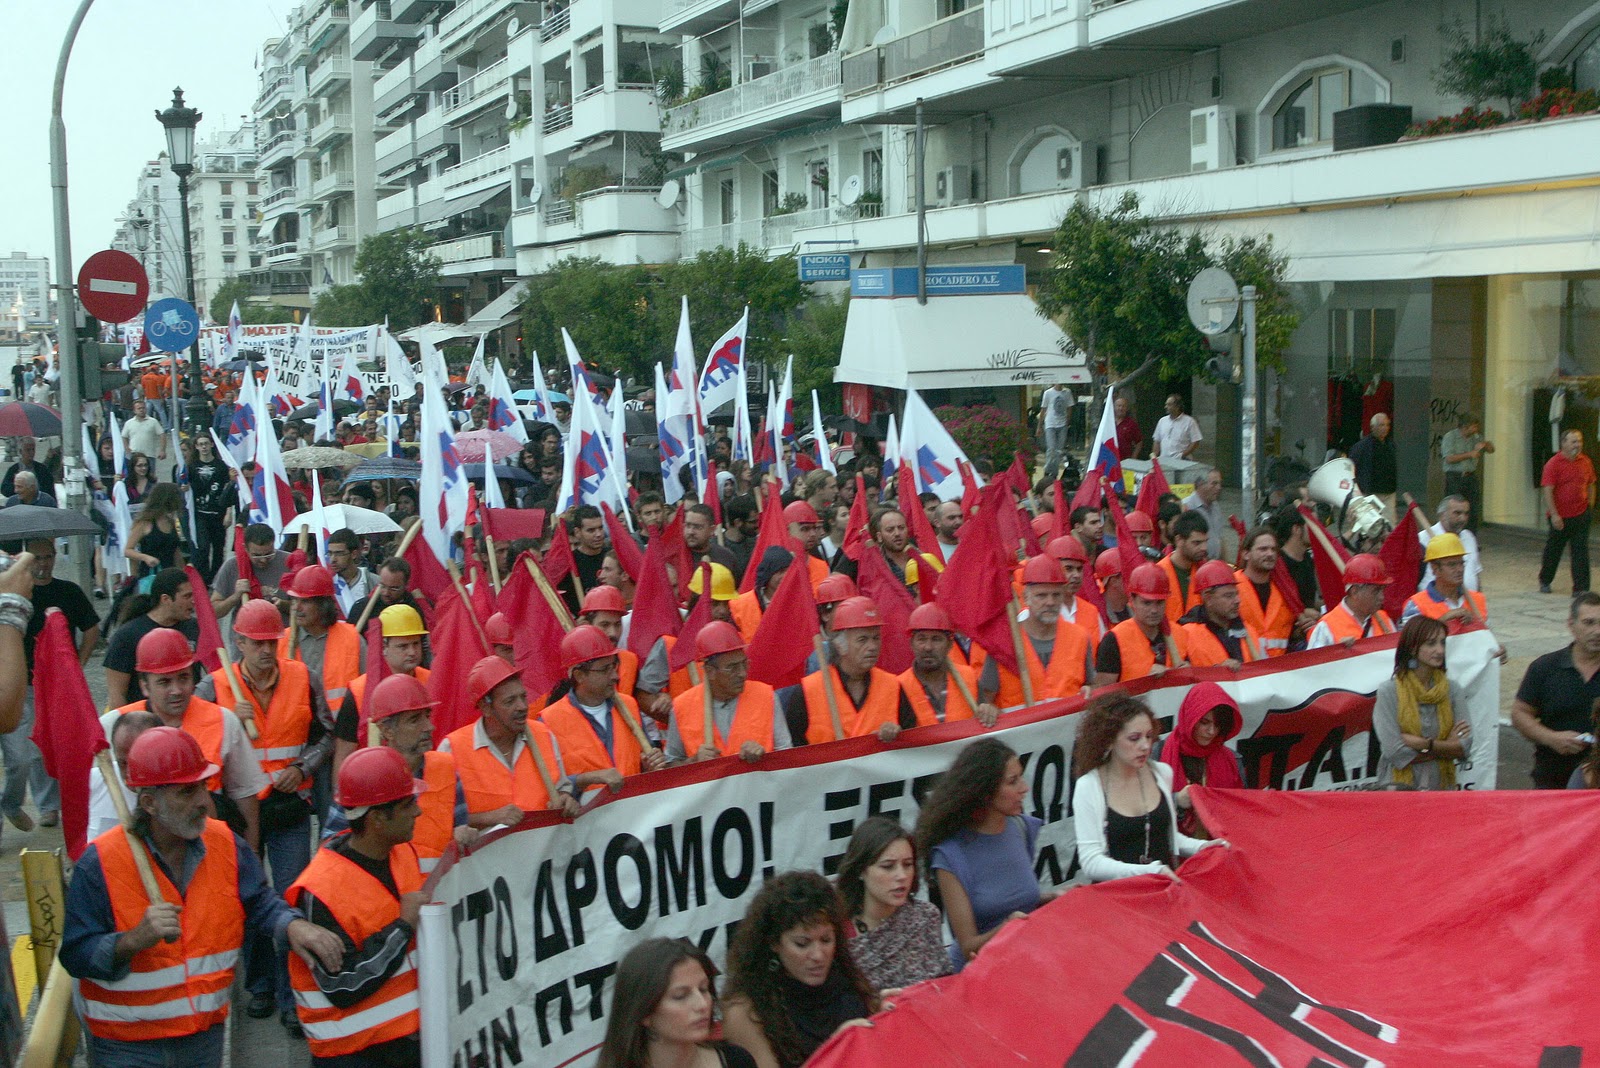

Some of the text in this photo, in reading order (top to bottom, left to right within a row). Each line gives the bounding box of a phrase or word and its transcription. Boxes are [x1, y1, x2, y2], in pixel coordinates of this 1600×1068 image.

[805, 255, 846, 265] NOKIA
[805, 268, 847, 277] SERVICE
[925, 275, 980, 286] ROCADERO
[451, 876, 519, 1016] ΣΤΟ
[533, 801, 775, 965] ΔΡΟΜΟ!
[453, 1006, 524, 1068] ΗΝ
